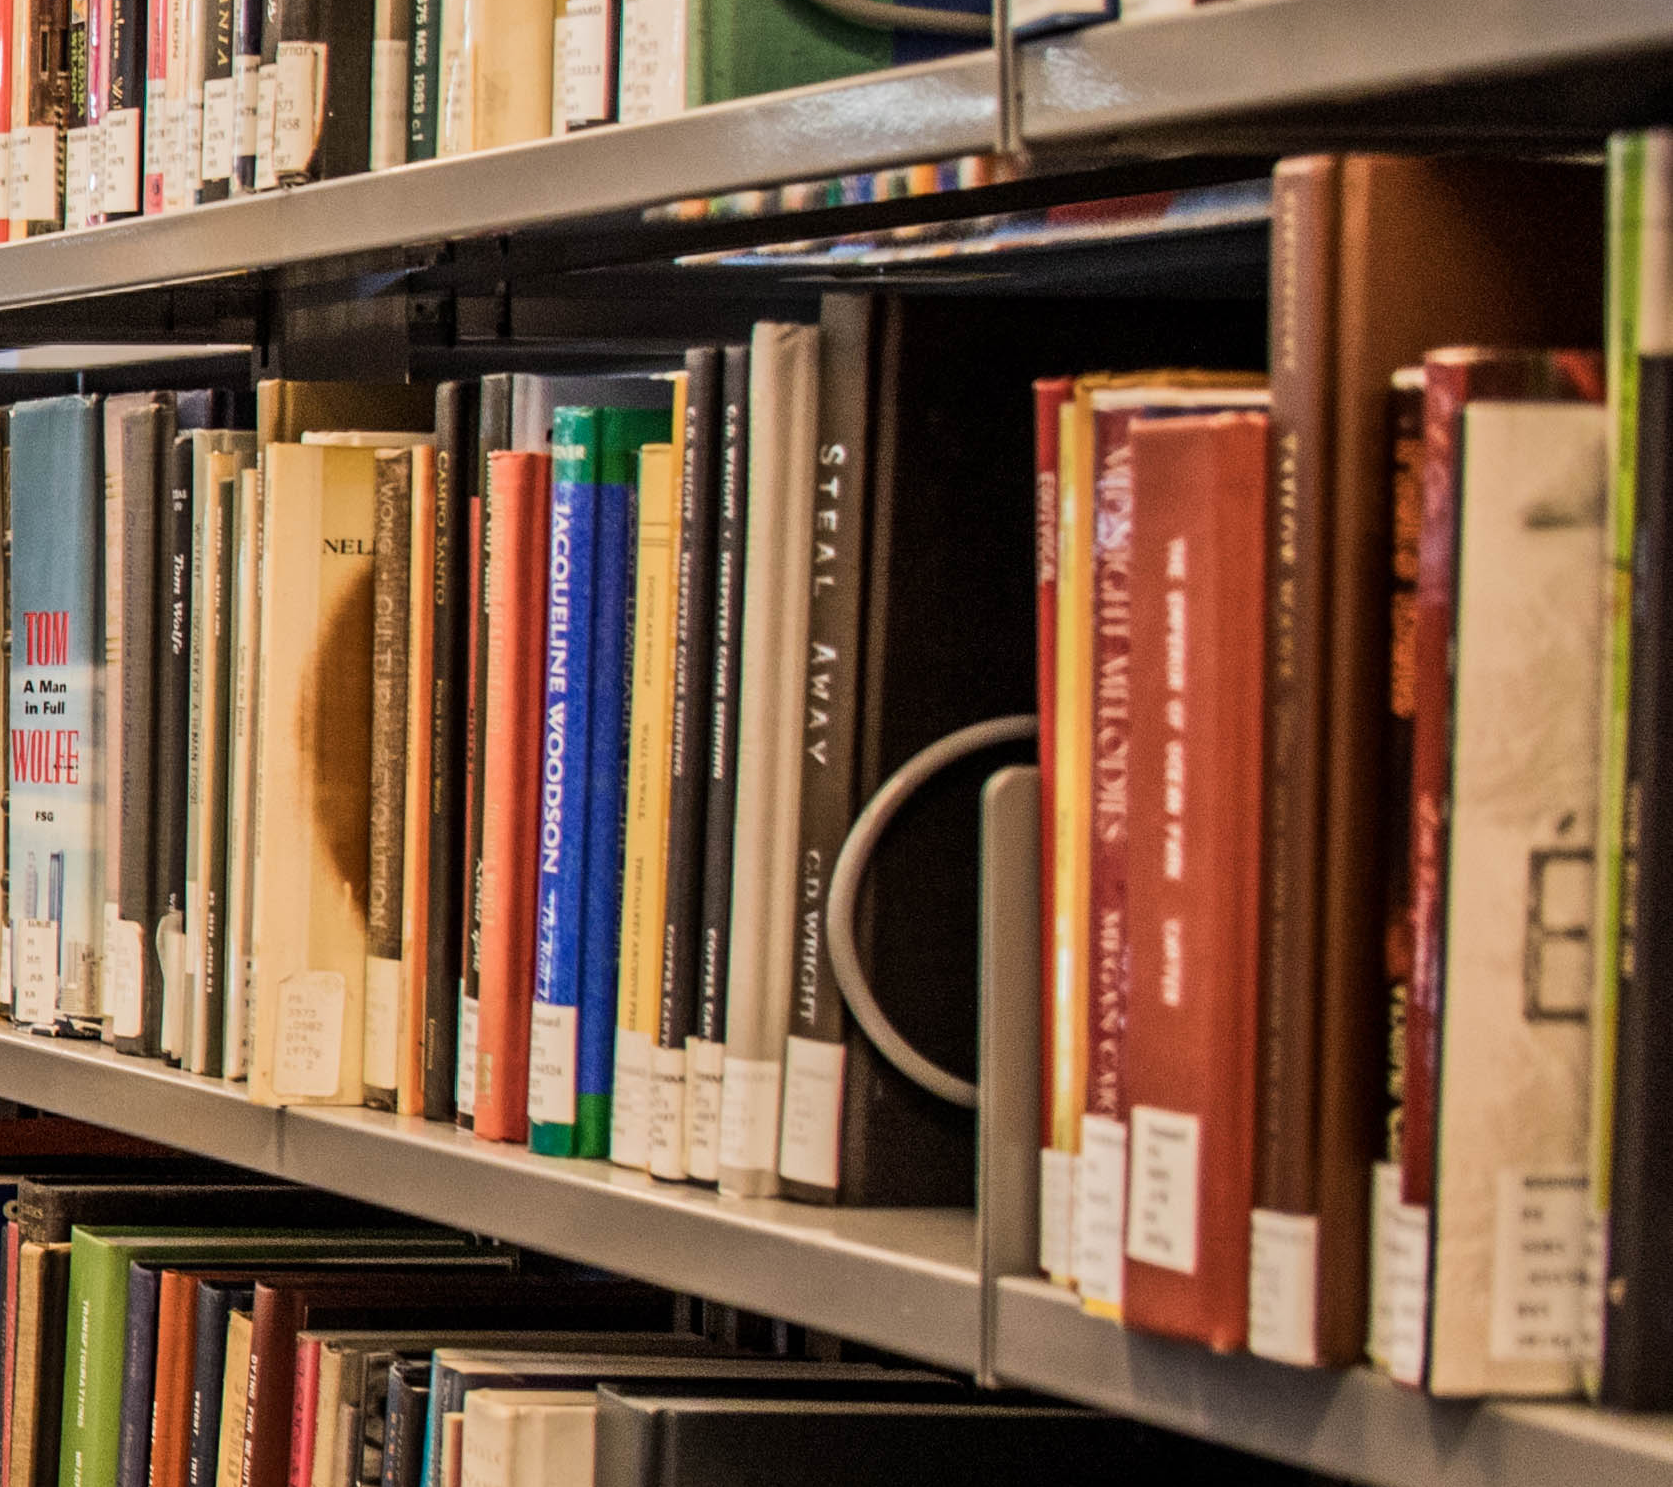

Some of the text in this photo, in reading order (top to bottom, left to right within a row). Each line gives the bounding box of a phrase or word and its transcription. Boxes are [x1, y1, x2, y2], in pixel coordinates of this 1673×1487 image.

[414, 29, 427, 66] M36
[413, 73, 426, 112] 1983
[171, 554, 185, 655] Tom Wolfe
[24, 611, 69, 666] TOM
[24, 680, 67, 694] A Man
[25, 702, 65, 715] in Full
[541, 505, 569, 873] JACQUELINE WOODSON
[800, 444, 844, 1024] STEAL AWAY C.D. WRIGHT
[12, 729, 79, 784] WOLFE
[35, 811, 54, 823] FSG
[75, 1300, 89, 1428] TRANSFIGURATIONS
[245, 1354, 259, 1398] DYING
[243, 1405, 256, 1433] FOR
